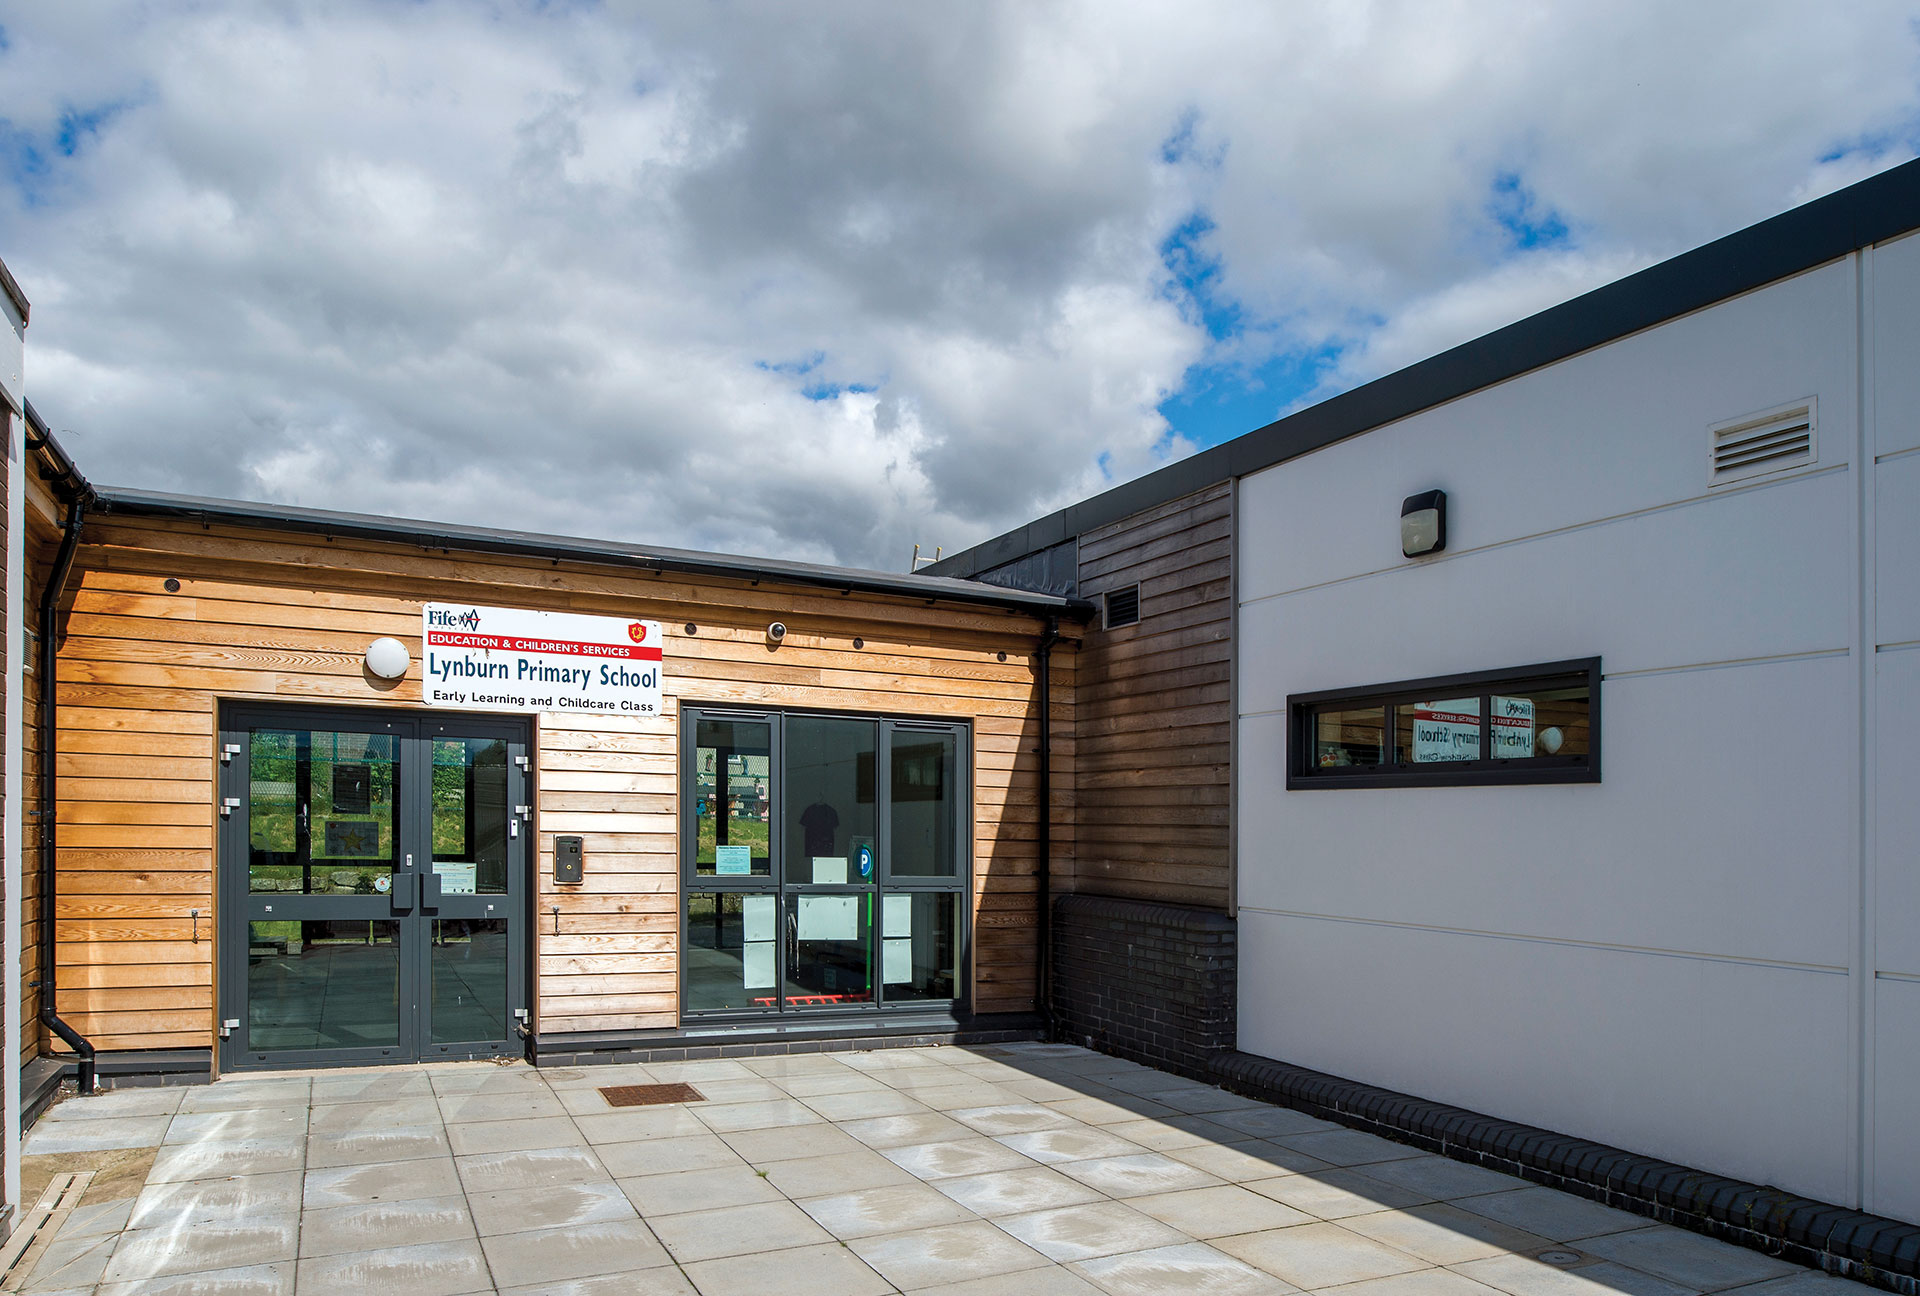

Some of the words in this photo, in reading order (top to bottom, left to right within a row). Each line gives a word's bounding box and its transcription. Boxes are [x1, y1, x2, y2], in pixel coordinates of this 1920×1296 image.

[428, 610, 457, 626] Fife
[430, 634, 498, 647] EDUCATION
[502, 639, 511, 648] &
[515, 641, 579, 653] CHILDREN'S
[583, 645, 630, 657] SERVICES
[430, 652, 509, 682] Lynburn
[518, 658, 591, 691] Primary
[600, 664, 656, 688] School
[433, 690, 466, 703] Early
[472, 692, 525, 706] Learning
[530, 696, 553, 706] and
[558, 697, 616, 709] Childcare
[620, 700, 654, 711] Class
[860, 854, 869, 870] P
